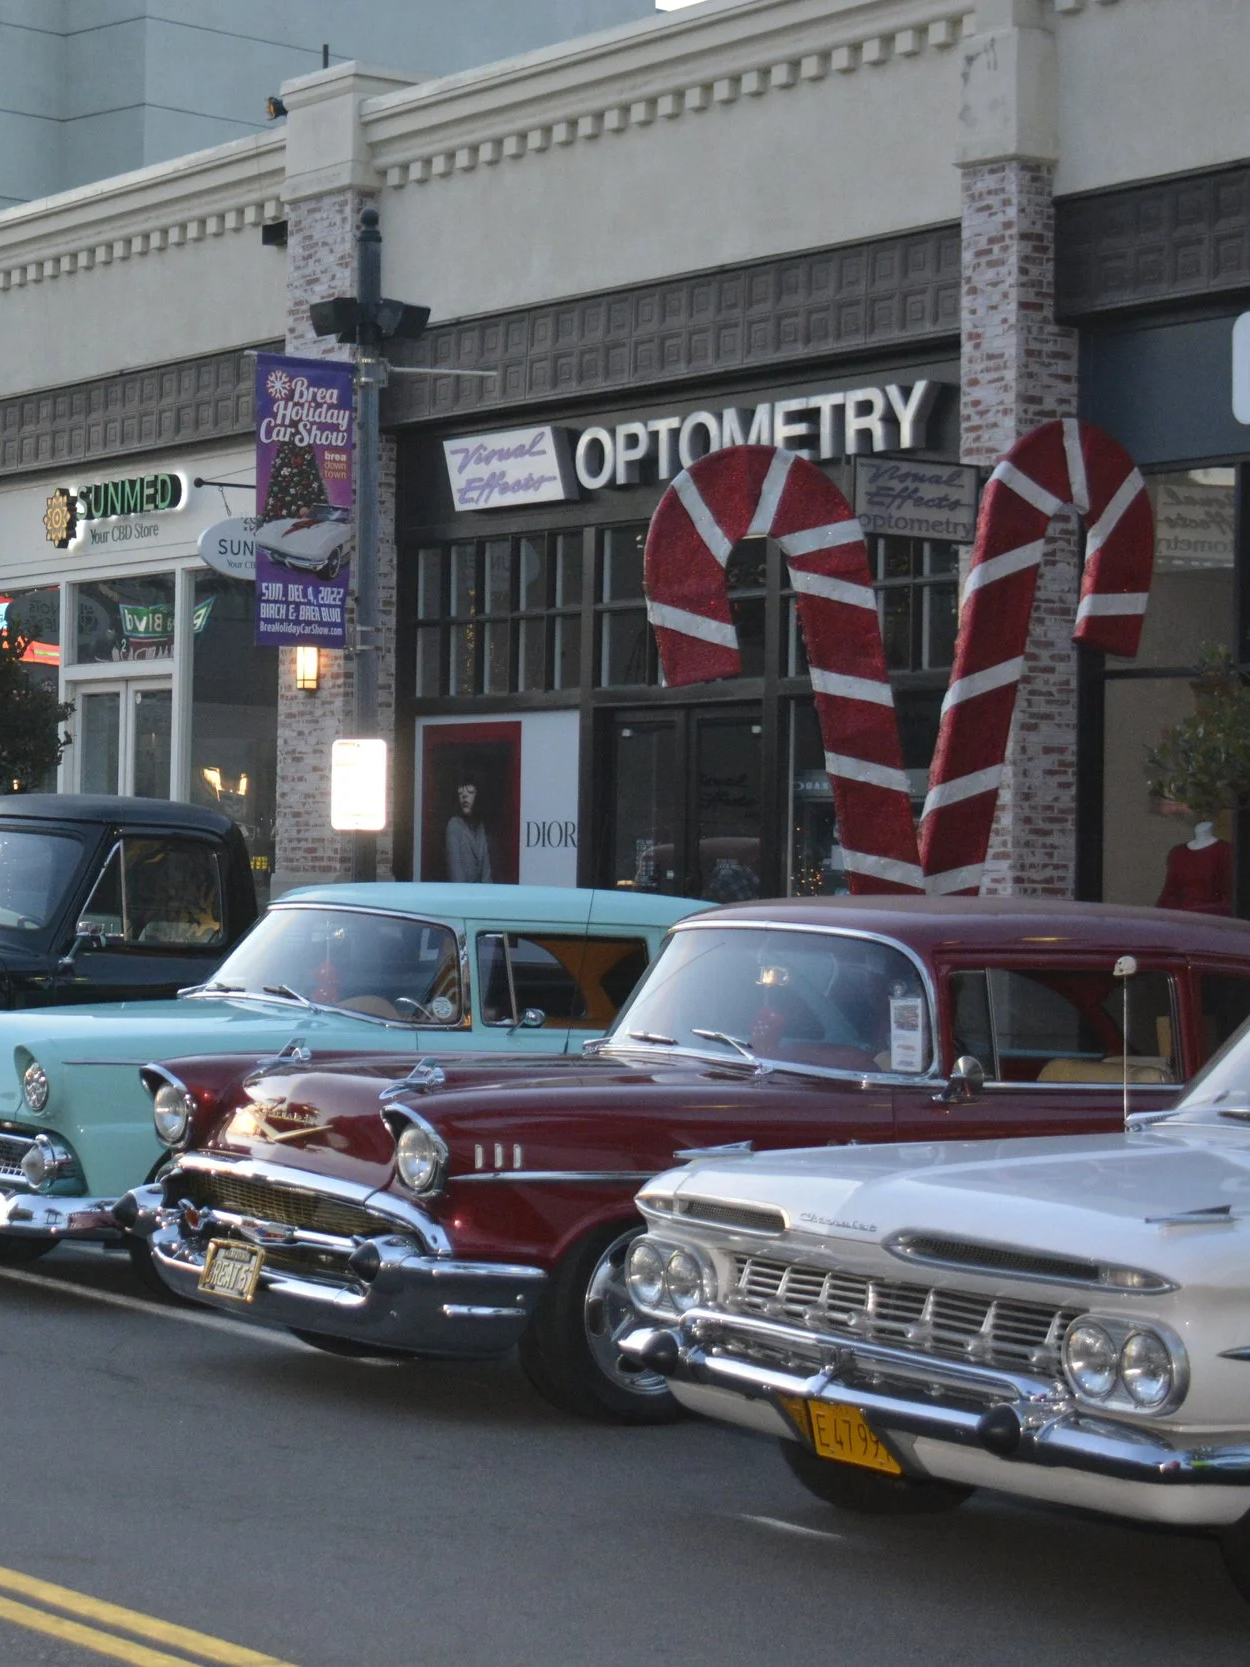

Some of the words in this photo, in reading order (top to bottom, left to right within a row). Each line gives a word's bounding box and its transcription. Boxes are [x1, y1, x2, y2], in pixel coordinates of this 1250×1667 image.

[291, 377, 338, 404] Brea
[273, 400, 350, 431] Holiday
[259, 416, 295, 445] Car
[294, 421, 348, 448] Show
[575, 380, 934, 489] OPTOMETRY
[324, 450, 347, 462] brea
[450, 426, 548, 474] Visual
[324, 461, 347, 471] down
[324, 470, 347, 480] town
[861, 463, 965, 489] Visual
[77, 473, 174, 521] SUNMED
[456, 470, 557, 505] Effects
[90, 527, 110, 545] Your
[111, 526, 133, 543] CBD
[134, 523, 159, 539] Store
[858, 512, 977, 540] optometry
[217, 538, 254, 557] SUN
[261, 582, 286, 601] SUN.
[288, 584, 307, 602] DEC.
[307, 586, 317, 605] 4,
[318, 586, 344, 605] 2022
[260, 603, 287, 619] BIRCH
[288, 604, 297, 620] &
[299, 605, 321, 622] BREA
[321, 607, 341, 622] BLVD
[260, 620, 343, 637] BreaHolidayCarShow.com
[525, 819, 578, 850] DIOR
